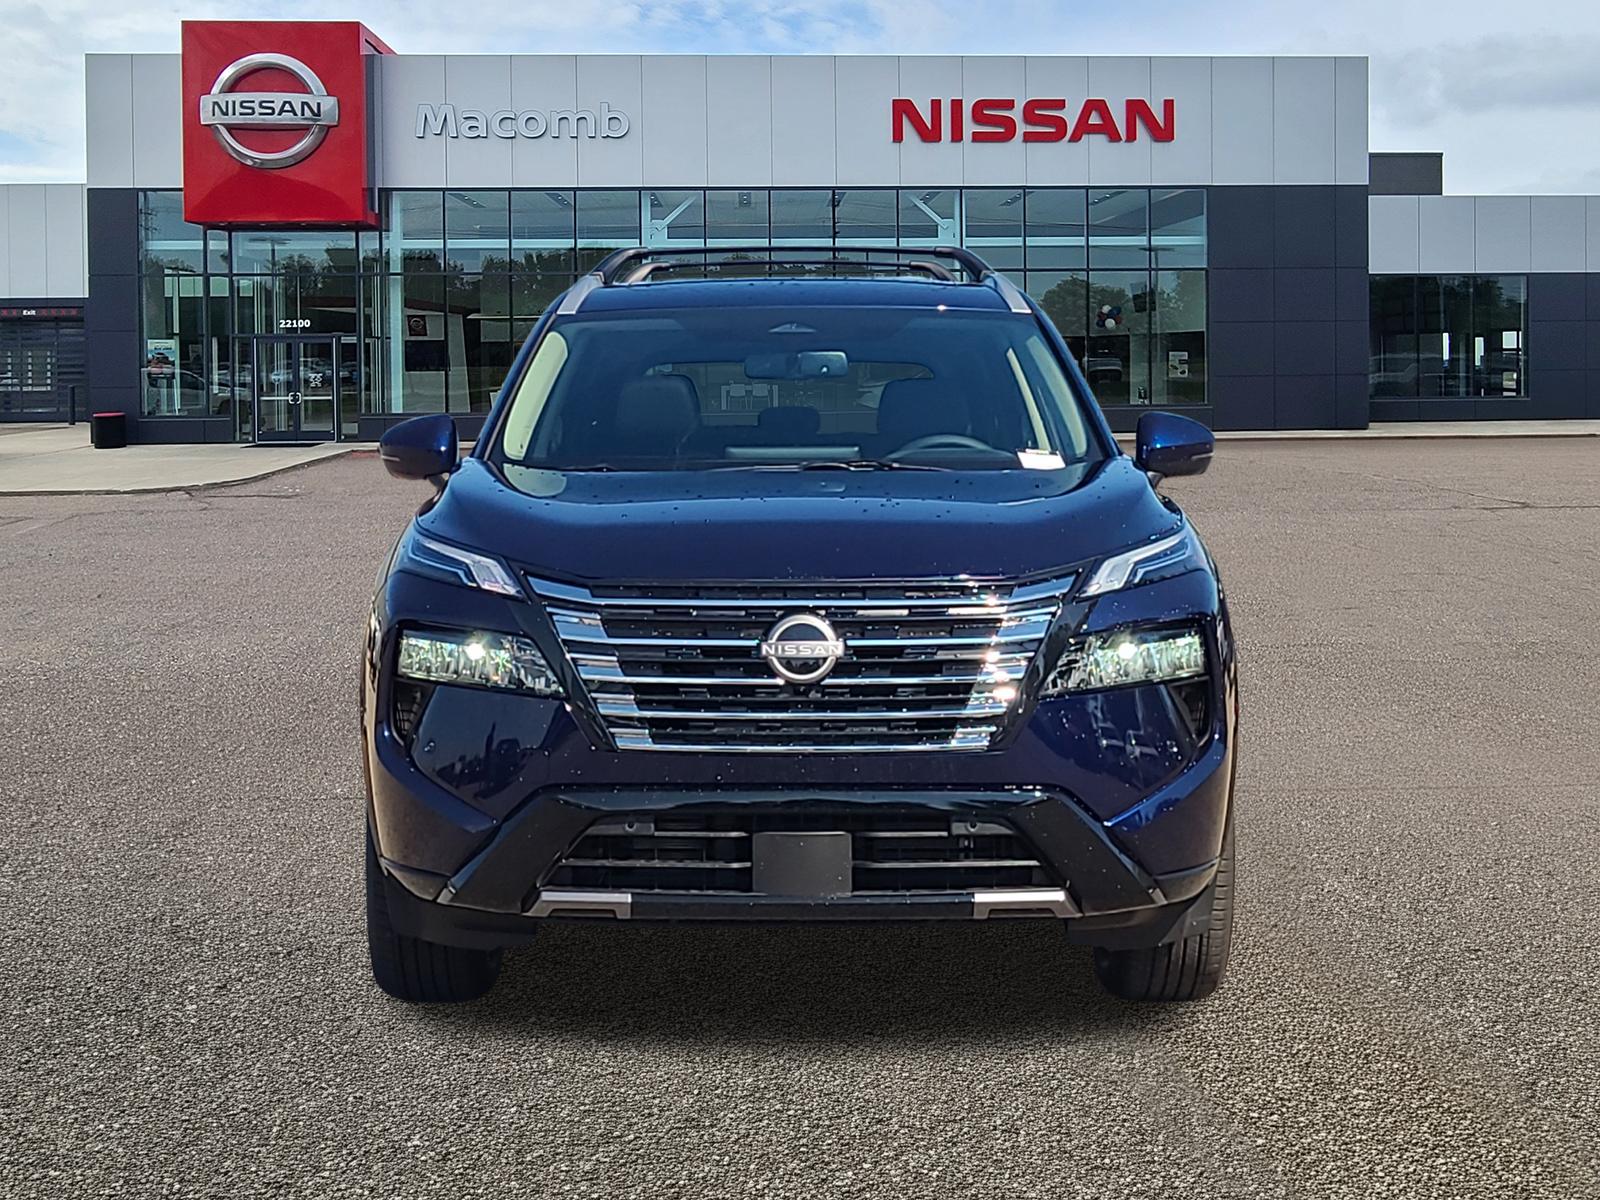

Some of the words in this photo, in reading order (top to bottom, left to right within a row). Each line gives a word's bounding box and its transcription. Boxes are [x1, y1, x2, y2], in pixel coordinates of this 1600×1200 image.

[212, 100, 322, 117] NISSAN
[415, 102, 630, 139] Macomb
[892, 98, 1175, 142] NISSAN
[279, 319, 311, 328] 22100
[762, 644, 842, 656] NISSAN
